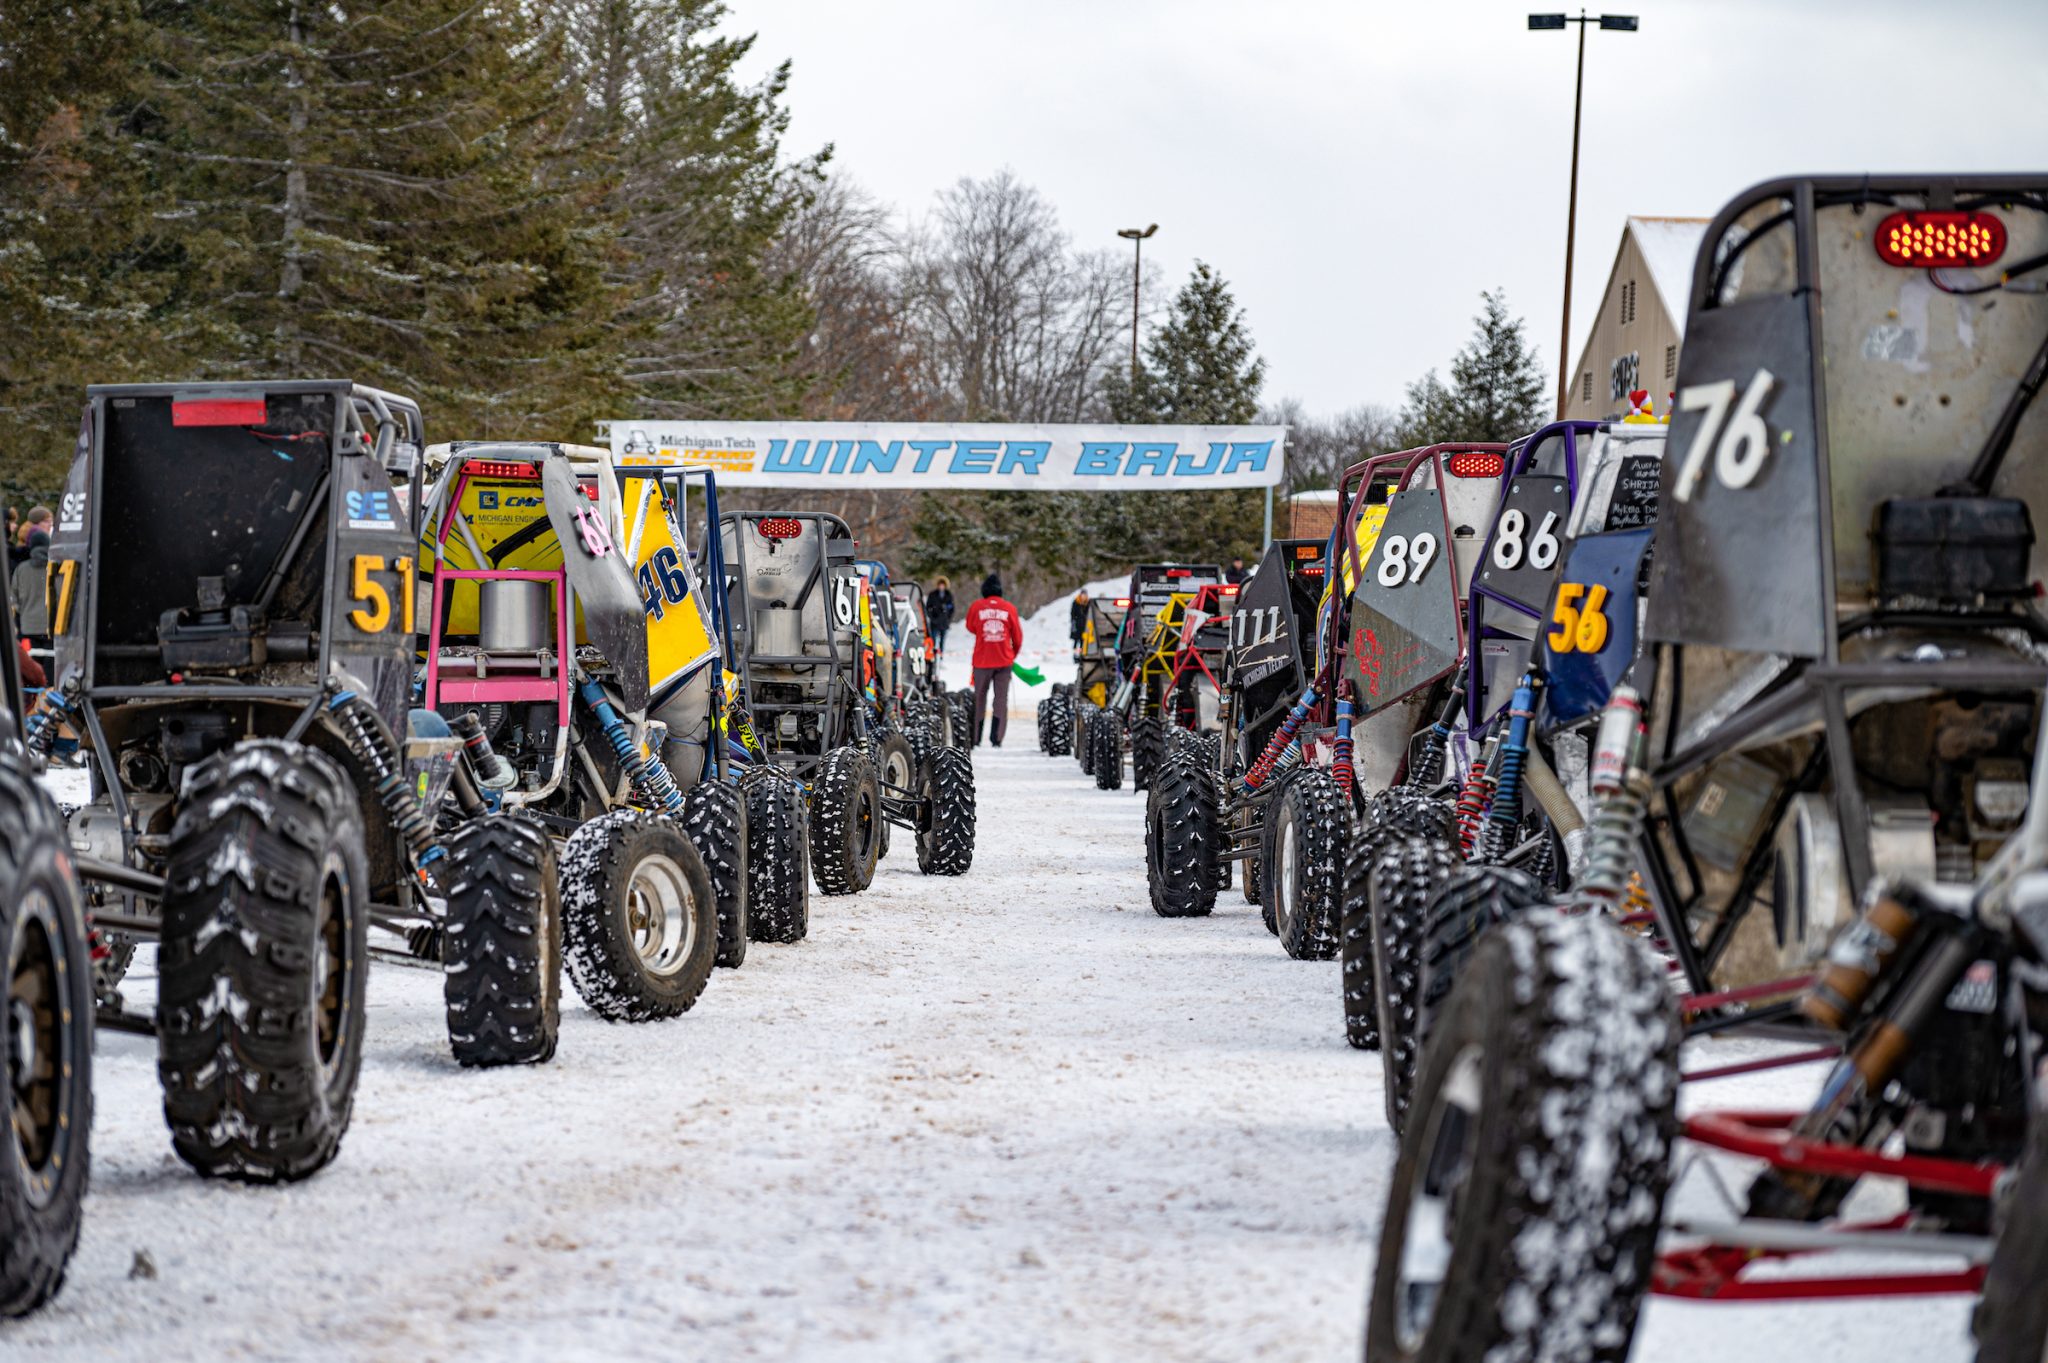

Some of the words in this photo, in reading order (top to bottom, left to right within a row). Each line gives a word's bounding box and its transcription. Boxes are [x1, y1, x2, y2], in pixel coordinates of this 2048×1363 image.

[660, 434, 722, 448] Michigan
[725, 437, 756, 448] Tech
[762, 438, 1053, 474] WINTER
[1074, 439, 1276, 476] BAJA
[1672, 367, 1775, 503] 76
[346, 490, 391, 521] SAE
[1377, 531, 1437, 588] 89
[1493, 508, 1560, 570] 86
[352, 554, 414, 634] 51
[637, 545, 690, 623] 46
[832, 575, 861, 625] 67
[1235, 605, 1280, 648] 111
[1548, 582, 1608, 653] 56
[1242, 663, 1268, 690] MICHIGAN
[1267, 659, 1285, 674] TECH
